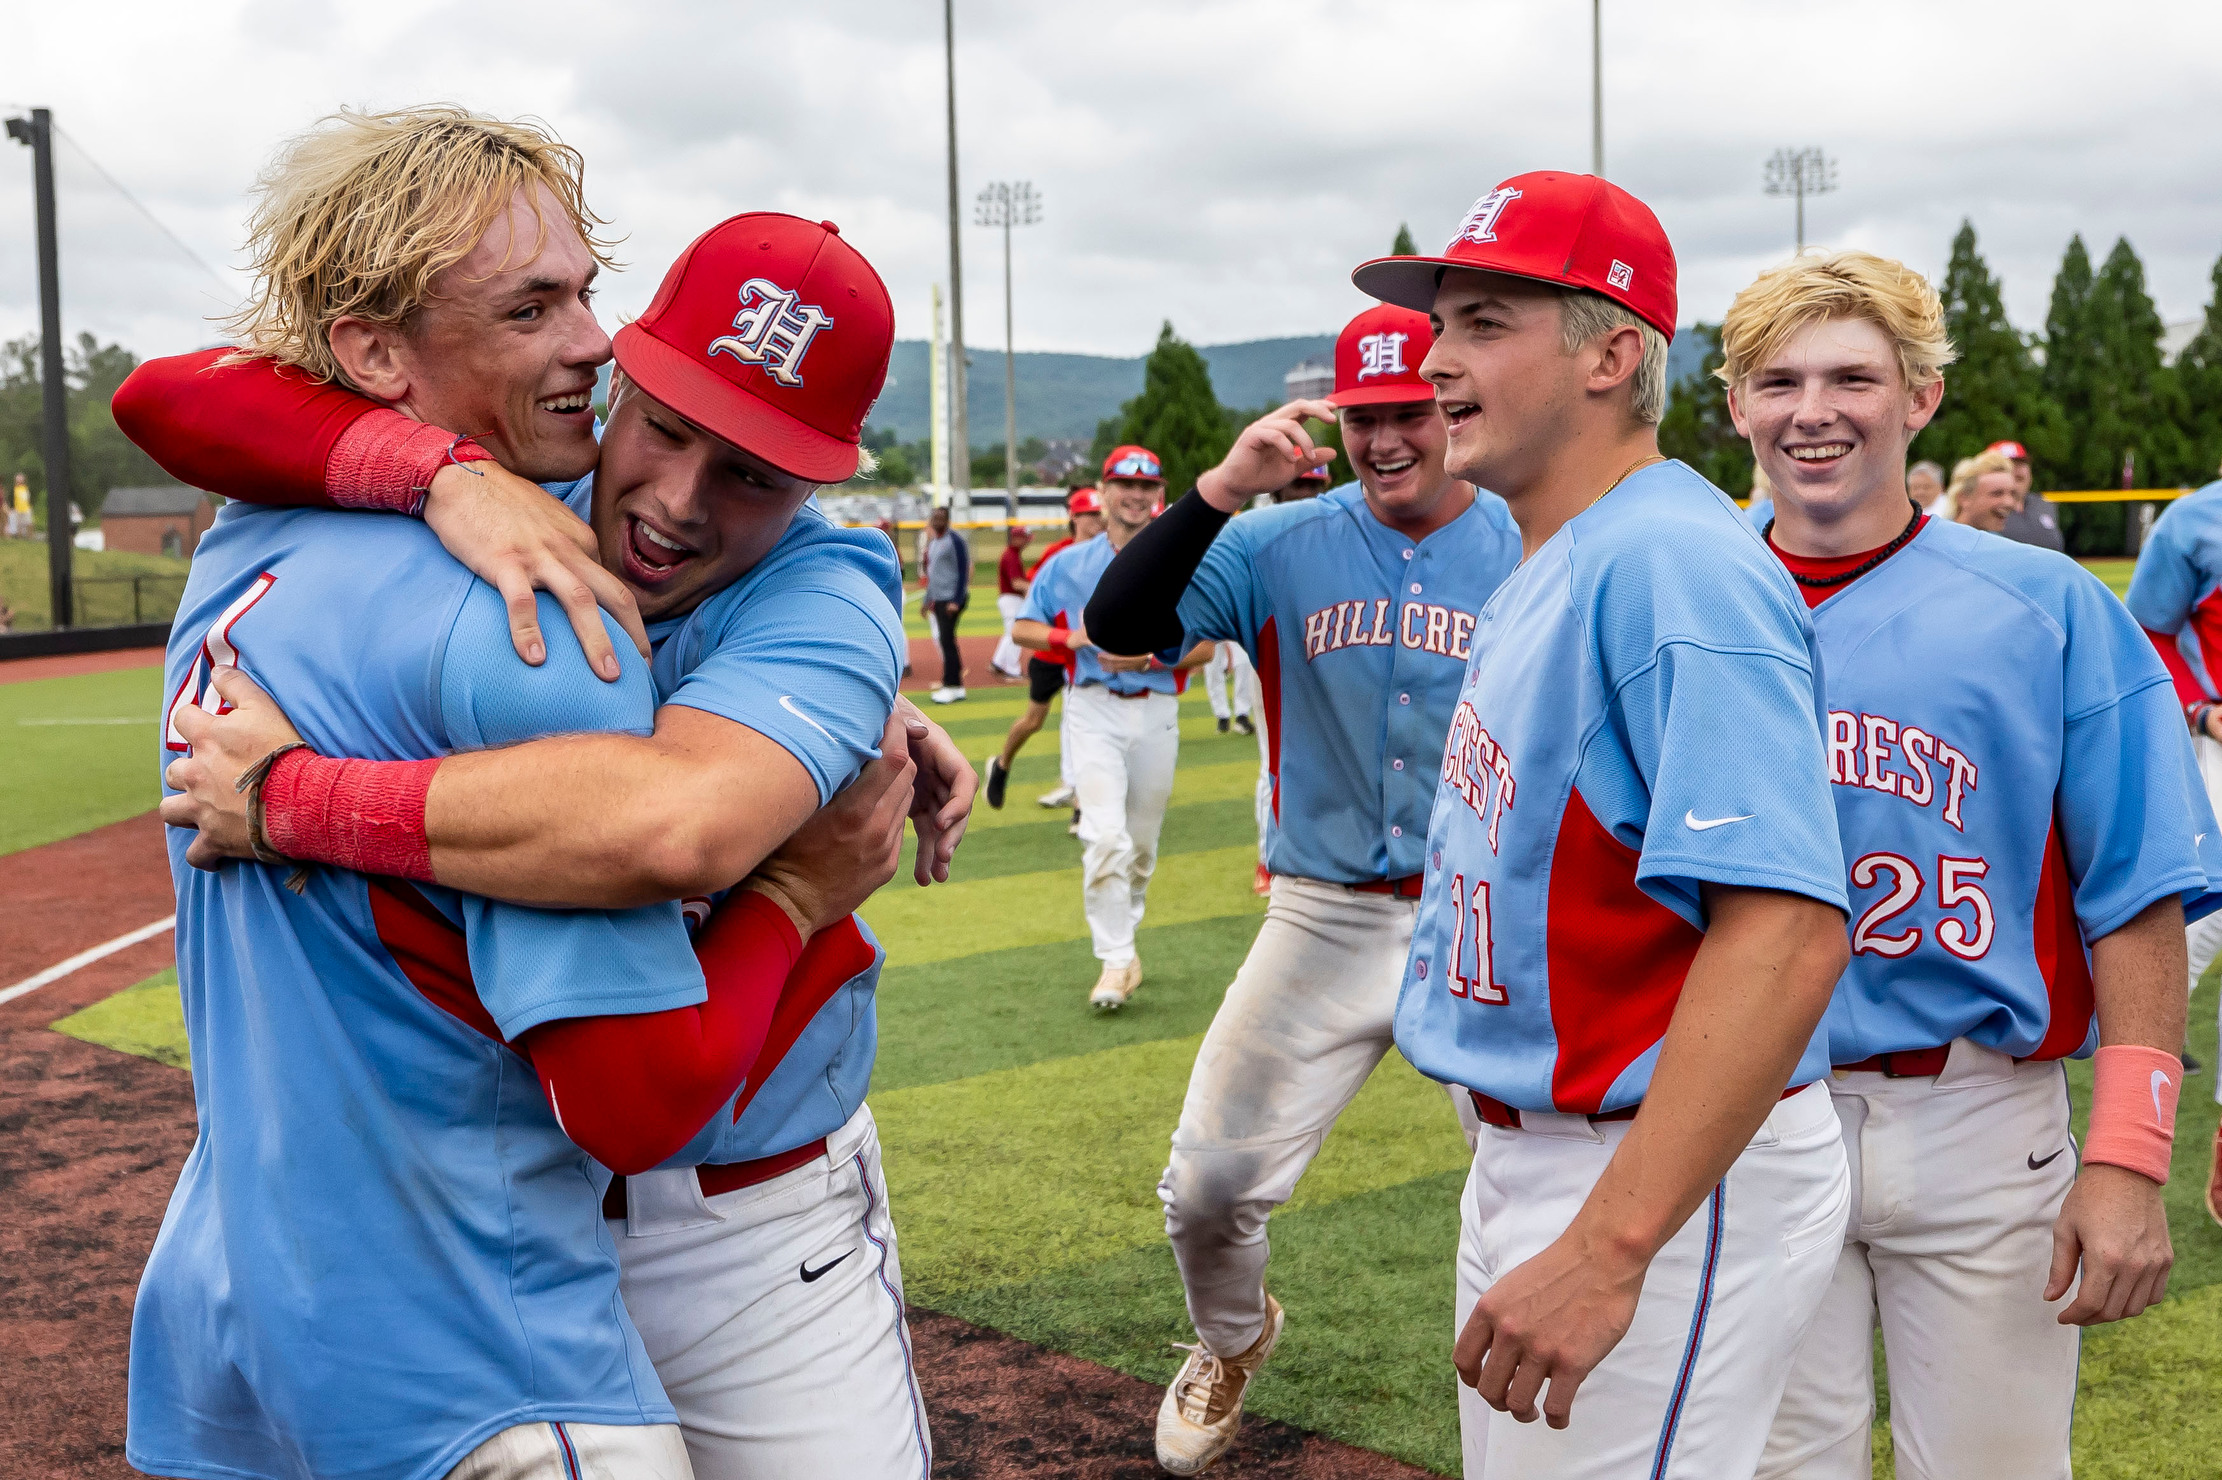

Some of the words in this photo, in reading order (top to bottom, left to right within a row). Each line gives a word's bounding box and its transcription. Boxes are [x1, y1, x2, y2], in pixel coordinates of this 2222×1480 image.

[707, 278, 834, 388] H
[1357, 331, 1410, 382] H
[1447, 873, 1510, 1006] 11
[1851, 851, 1996, 961] 25
